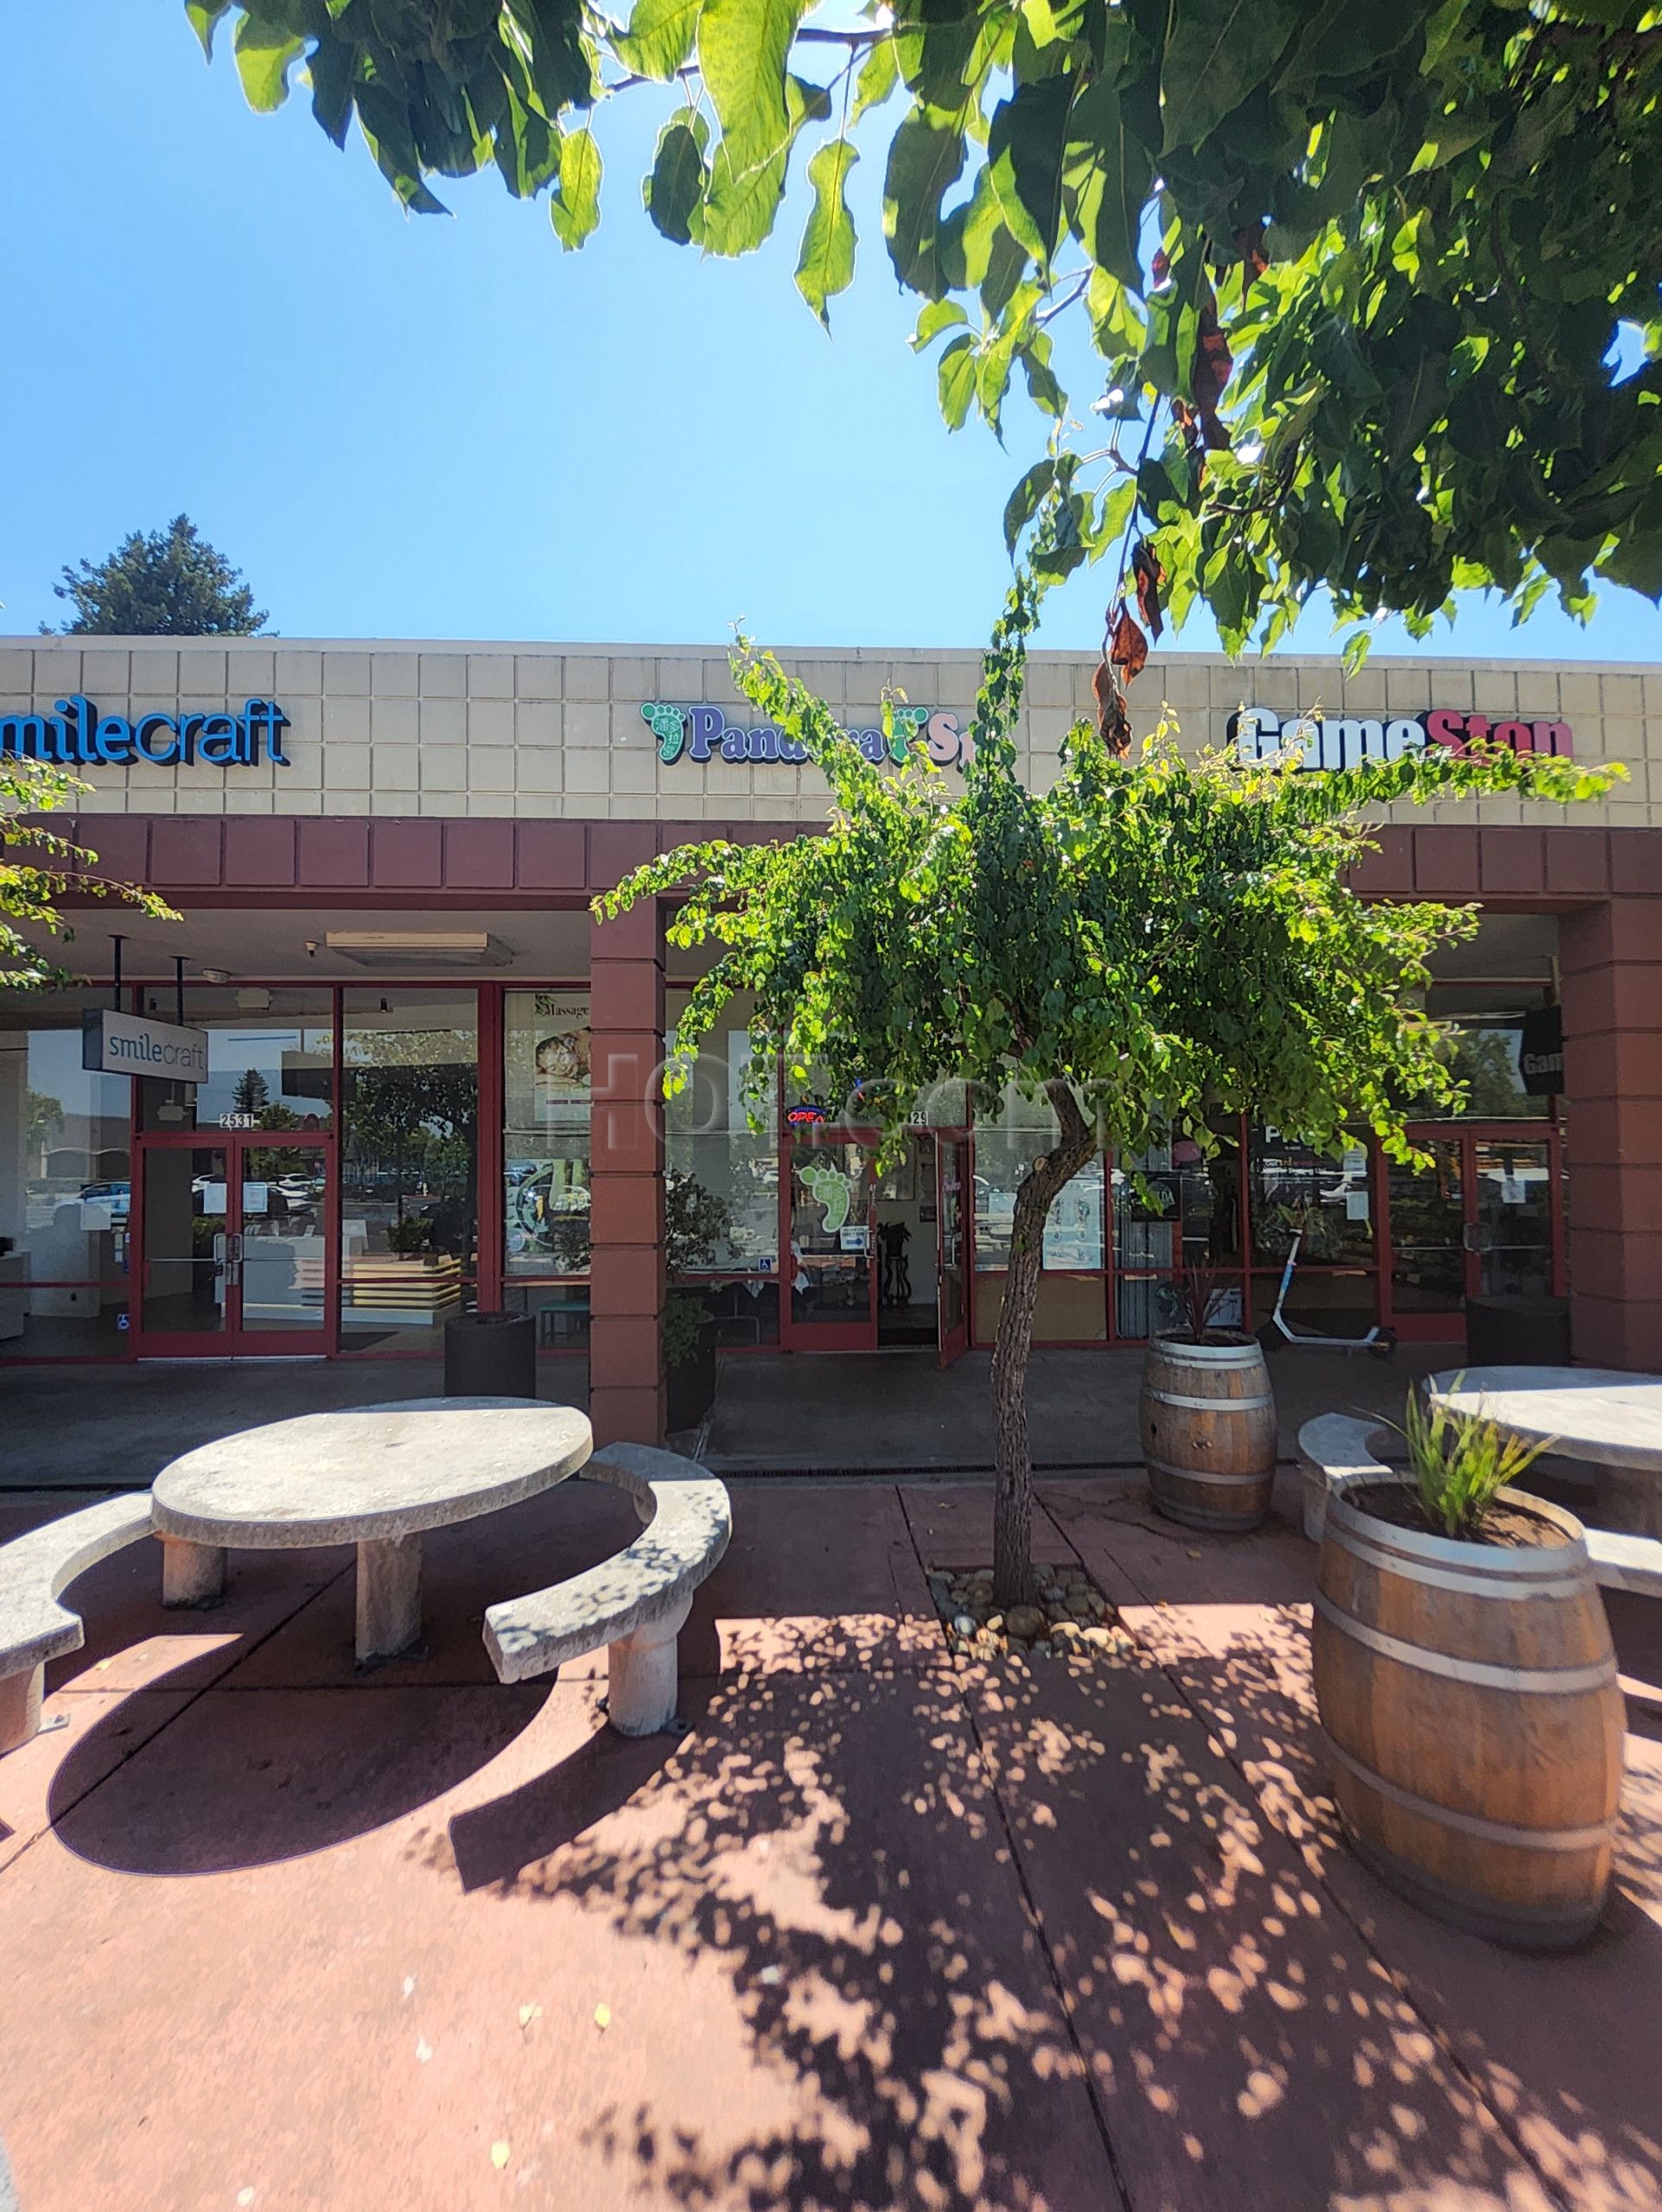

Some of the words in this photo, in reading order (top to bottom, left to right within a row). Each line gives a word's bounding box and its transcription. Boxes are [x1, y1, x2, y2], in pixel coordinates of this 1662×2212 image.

[689, 706, 886, 760] Panda
[109, 1033, 204, 1070] smilecraft
[221, 1114, 253, 1128] 2531
